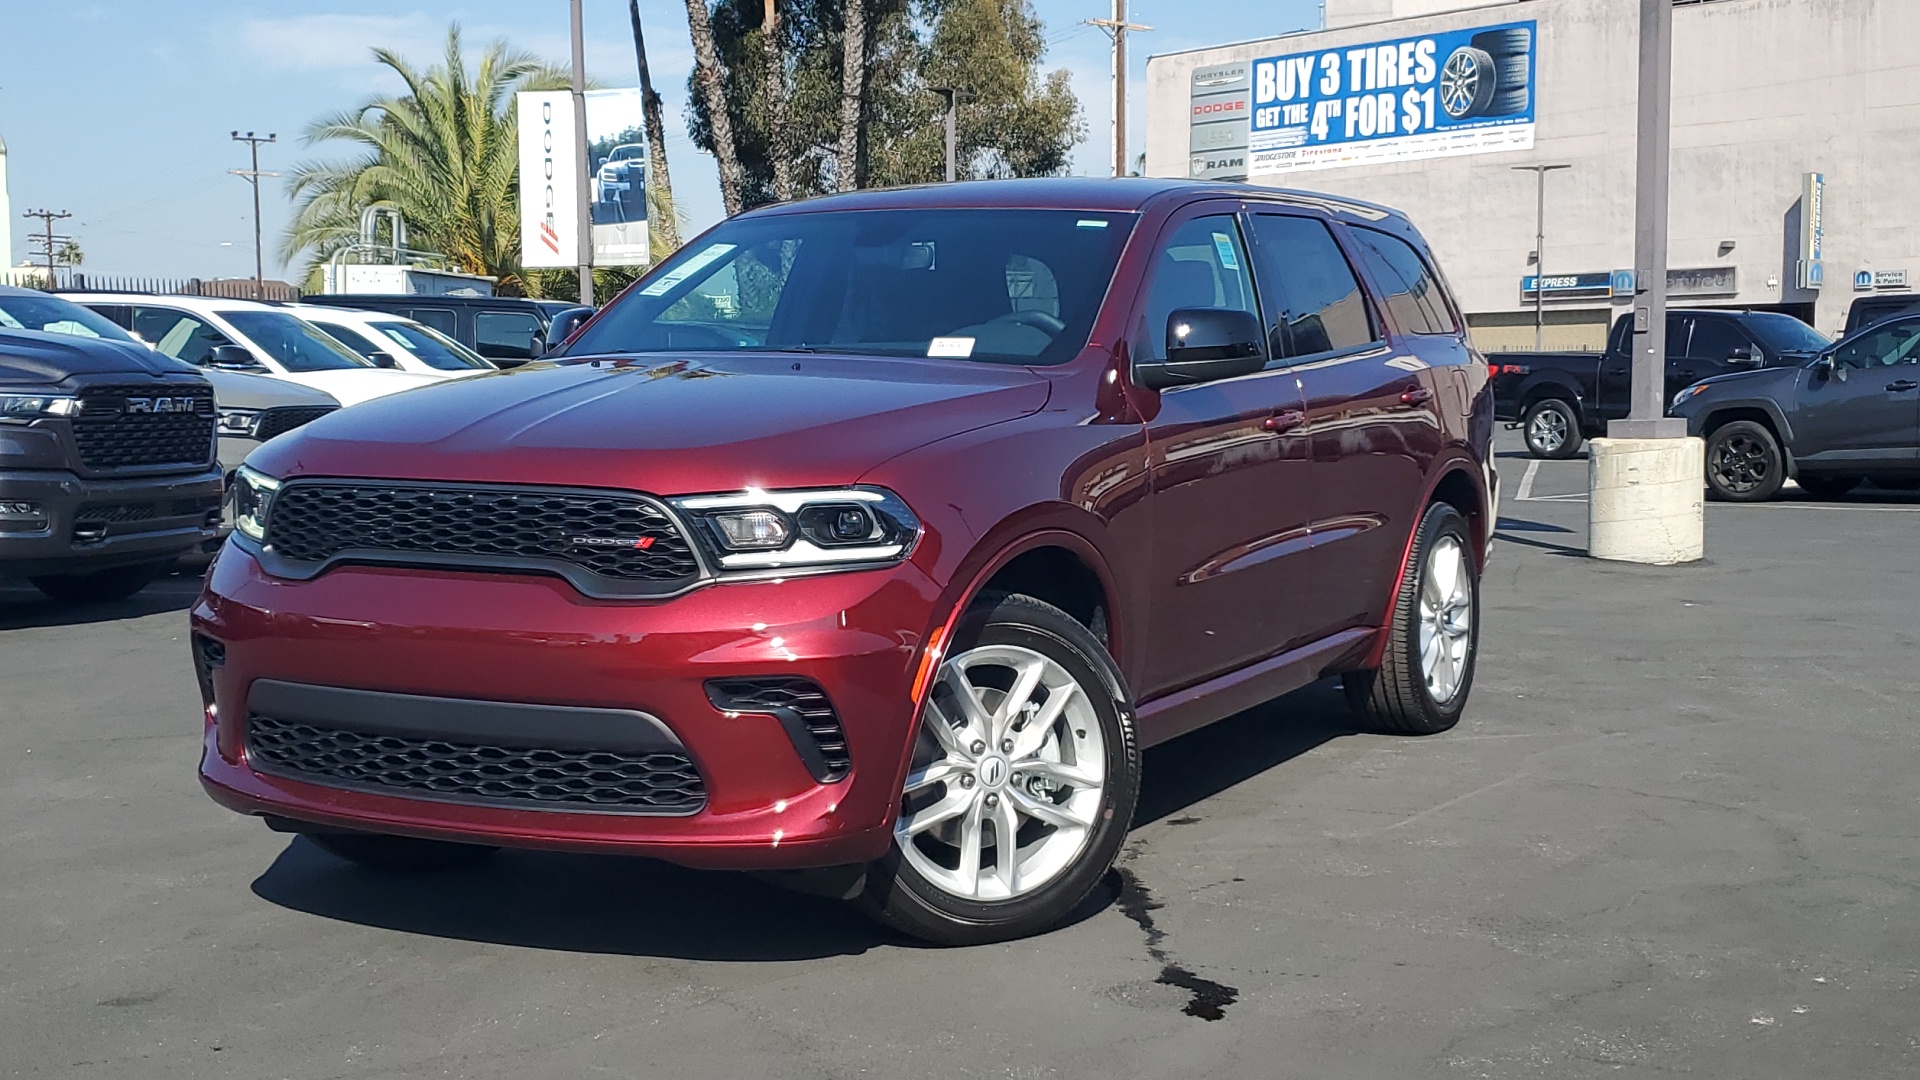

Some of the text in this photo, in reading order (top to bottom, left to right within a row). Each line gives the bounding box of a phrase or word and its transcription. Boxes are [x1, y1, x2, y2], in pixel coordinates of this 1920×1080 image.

[1194, 68, 1244, 80] CHRYSLER
[1256, 39, 1436, 104] BUY 3 TIRES
[1193, 101, 1245, 115] DODGE
[1256, 106, 1281, 129] GET
[1282, 102, 1309, 126] THE
[1344, 92, 1396, 138] FOR
[1401, 86, 1435, 135] $1
[1206, 157, 1244, 170] RAM
[1530, 276, 1577, 289] EXPRESS
[125, 397, 195, 413] RAM
